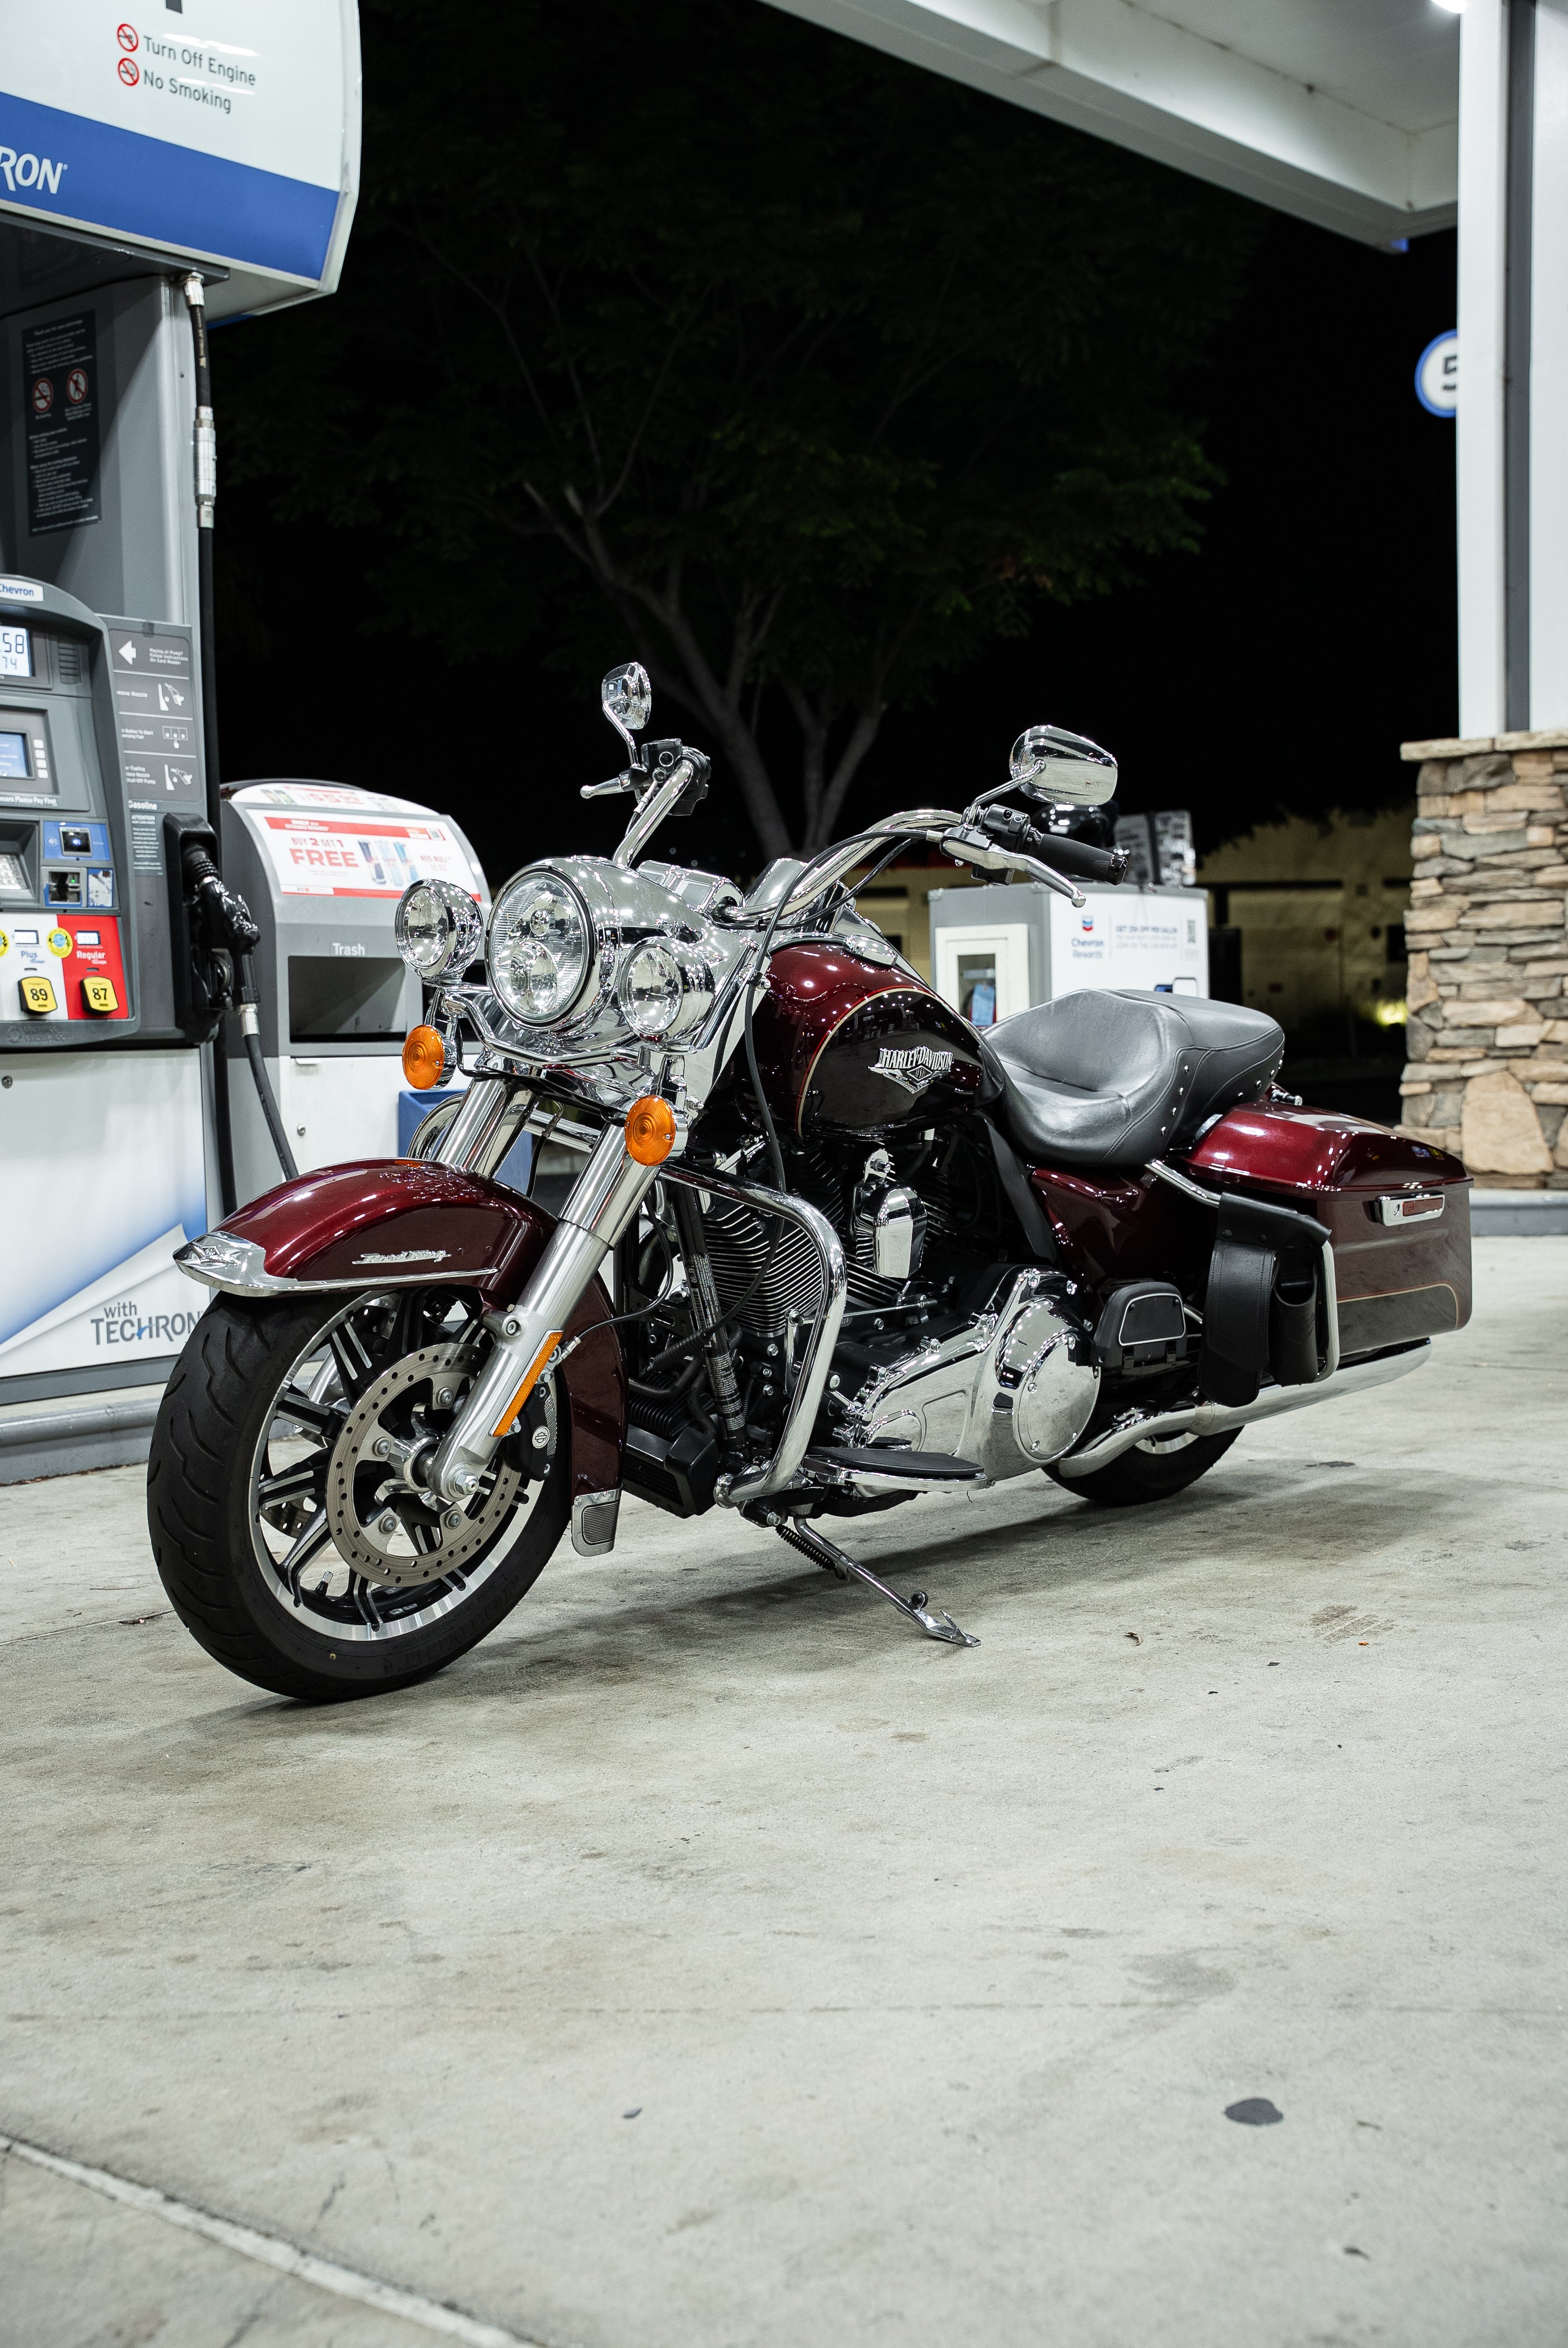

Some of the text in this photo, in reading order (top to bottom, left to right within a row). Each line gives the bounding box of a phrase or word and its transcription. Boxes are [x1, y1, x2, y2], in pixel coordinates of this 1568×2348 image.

[143, 35, 256, 86] Turn Off Engine
[143, 69, 231, 114] No Smoking
[309, 837, 319, 846] 2
[337, 840, 344, 848] 1
[289, 848, 359, 868] FREE
[332, 942, 365, 956] Trash
[1071, 938, 1103, 948] Chevron
[21, 950, 38, 959] Plus
[76, 950, 106, 960] Regular
[1072, 949, 1103, 959] Rewards
[30, 988, 48, 1001] 89
[92, 987, 108, 1000] 87
[879, 1046, 953, 1071] HARLEY-DAVIDSON
[104, 1301, 137, 1319] with
[91, 1311, 200, 1345] TECHRON
